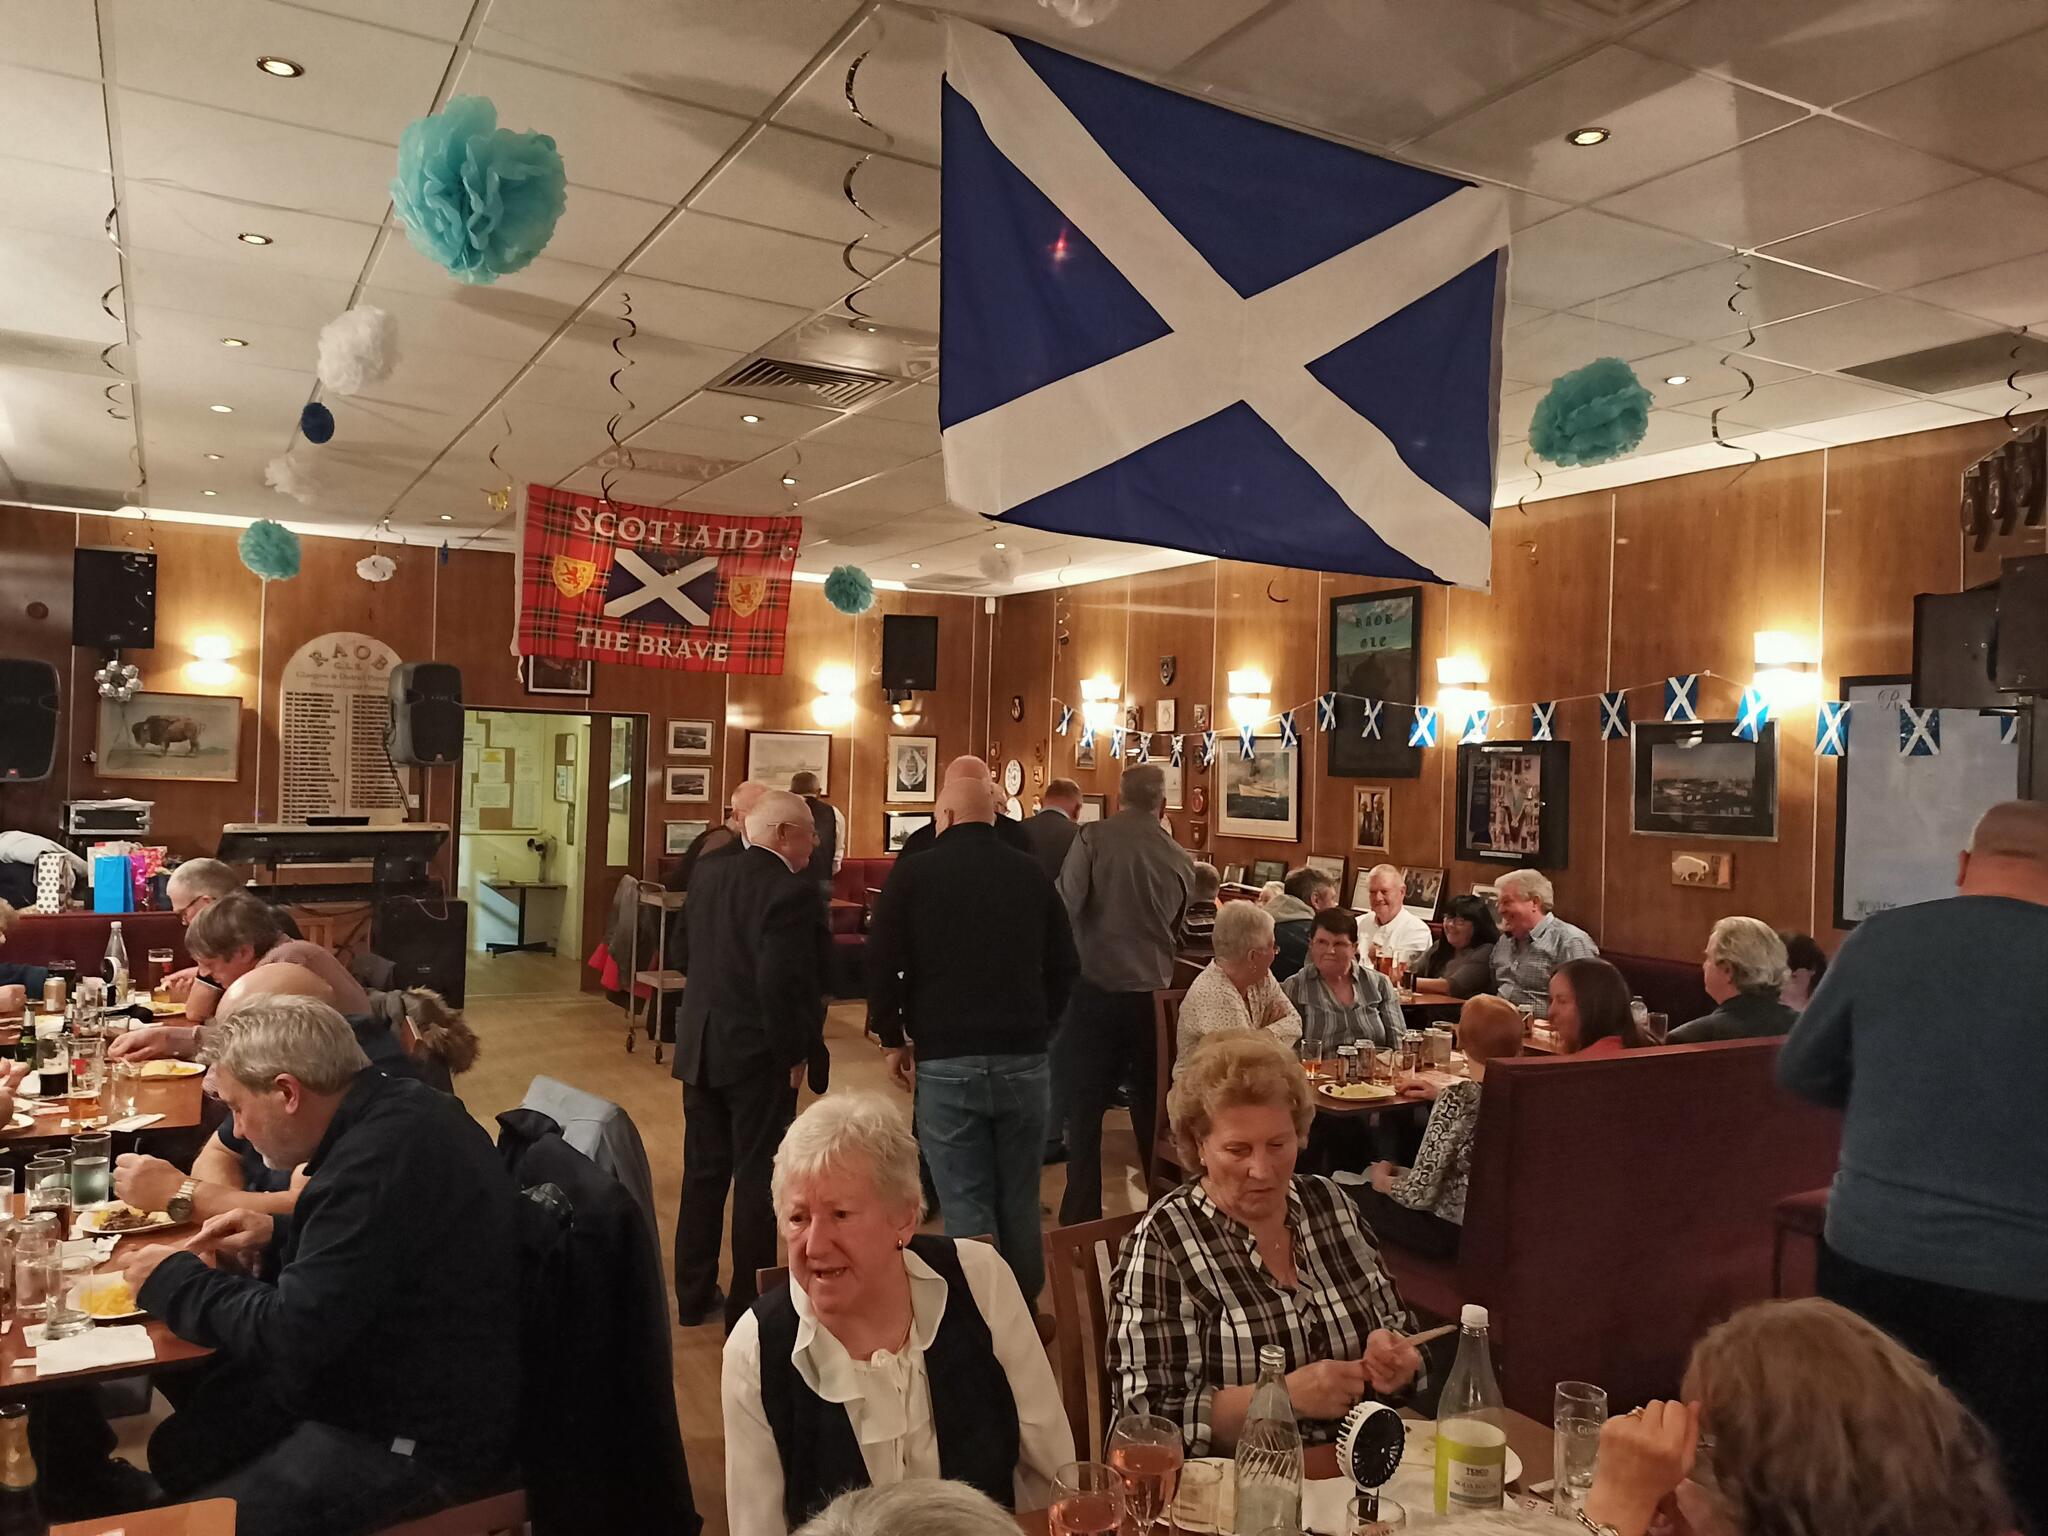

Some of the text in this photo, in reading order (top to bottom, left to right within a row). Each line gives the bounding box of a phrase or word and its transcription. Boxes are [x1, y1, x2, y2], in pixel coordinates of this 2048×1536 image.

[574, 506, 765, 549] SCOTLAND
[308, 643, 389, 671] RAOB
[576, 627, 729, 663] THE BRAVE
